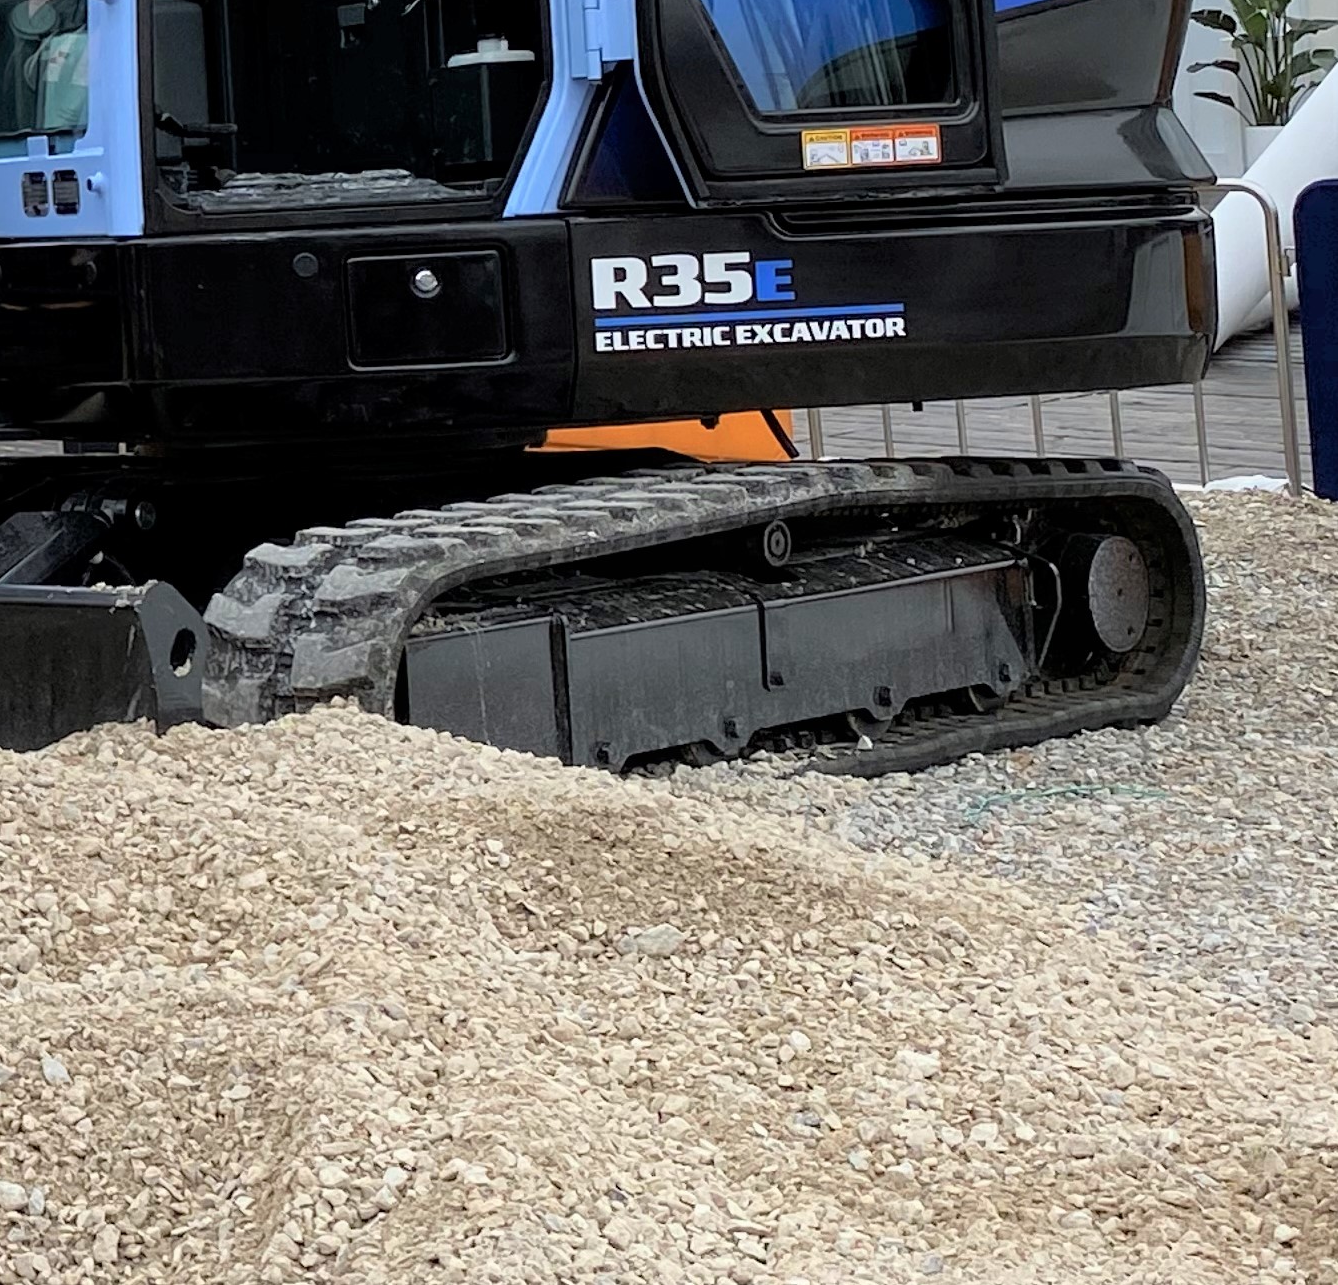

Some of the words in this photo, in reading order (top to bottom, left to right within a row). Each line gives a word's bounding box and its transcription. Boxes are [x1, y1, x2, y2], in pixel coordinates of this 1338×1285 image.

[591, 251, 796, 310] R35E
[595, 325, 731, 352] ELECTRIC
[736, 317, 907, 346] EXCAVATOR
